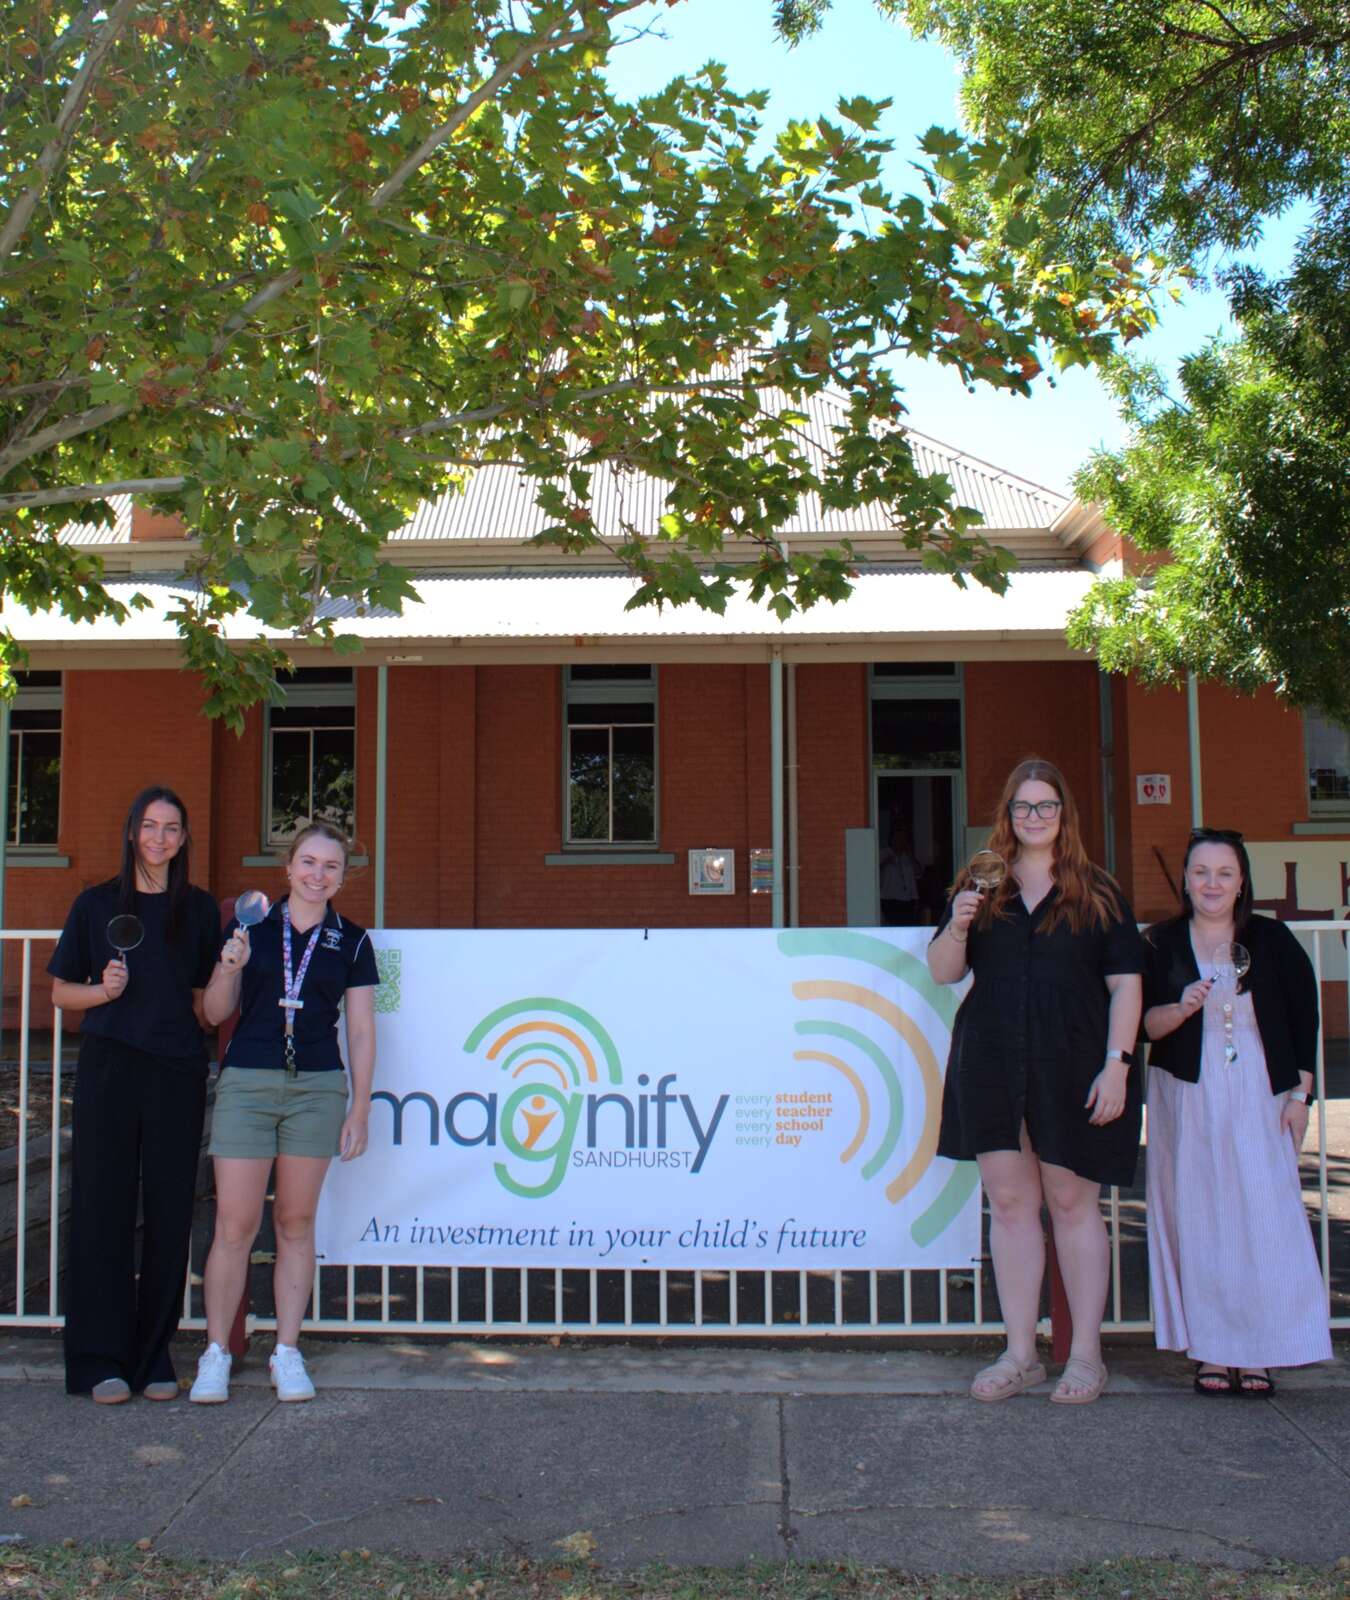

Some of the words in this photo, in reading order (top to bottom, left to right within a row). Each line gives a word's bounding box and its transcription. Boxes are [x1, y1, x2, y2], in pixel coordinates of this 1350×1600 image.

[735, 1095, 772, 1107] every
[776, 1092, 833, 1103] student
[735, 1108, 772, 1120] every
[776, 1105, 833, 1117] teacher
[735, 1122, 772, 1134] every
[776, 1119, 824, 1131] school
[369, 1073, 730, 1199] magnify
[735, 1136, 772, 1148] every
[776, 1133, 802, 1147] day
[572, 1150, 692, 1168] SANDHURST
[359, 1216, 400, 1243] An
[410, 1217, 560, 1247] investment
[568, 1221, 596, 1247] in
[599, 1227, 672, 1257] your
[775, 1217, 867, 1254] future
